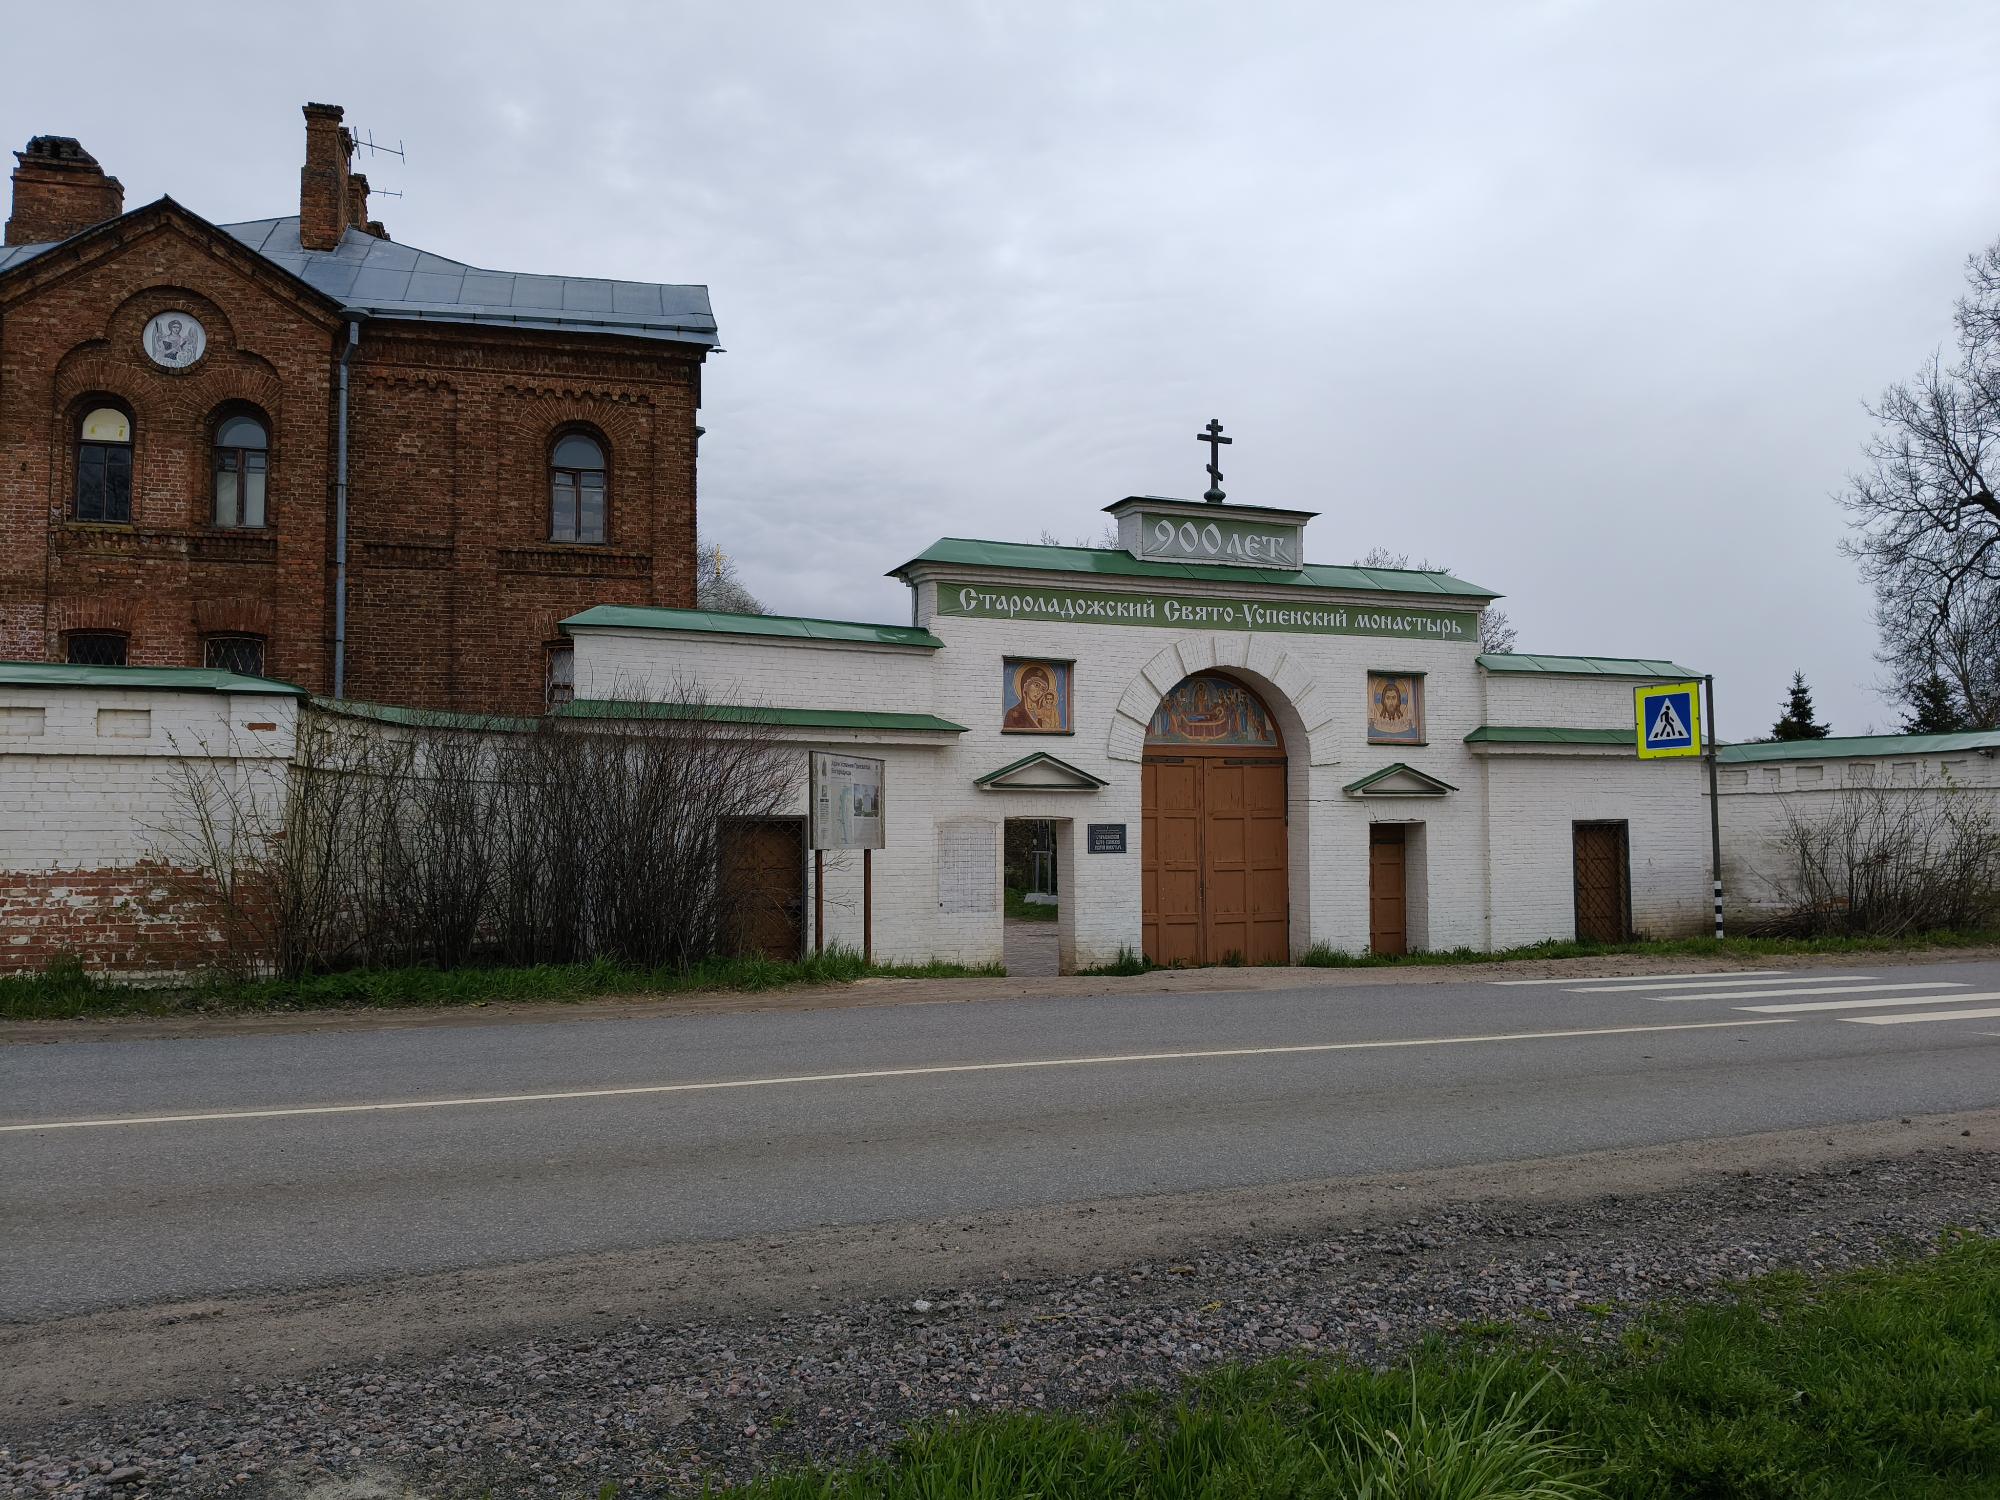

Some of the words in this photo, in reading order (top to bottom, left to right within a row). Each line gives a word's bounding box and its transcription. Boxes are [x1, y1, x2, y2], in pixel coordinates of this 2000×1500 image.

[1152, 519, 1222, 555] 900
[959, 588, 1156, 619] Староладожский
[1354, 612, 1463, 639] монастырь
